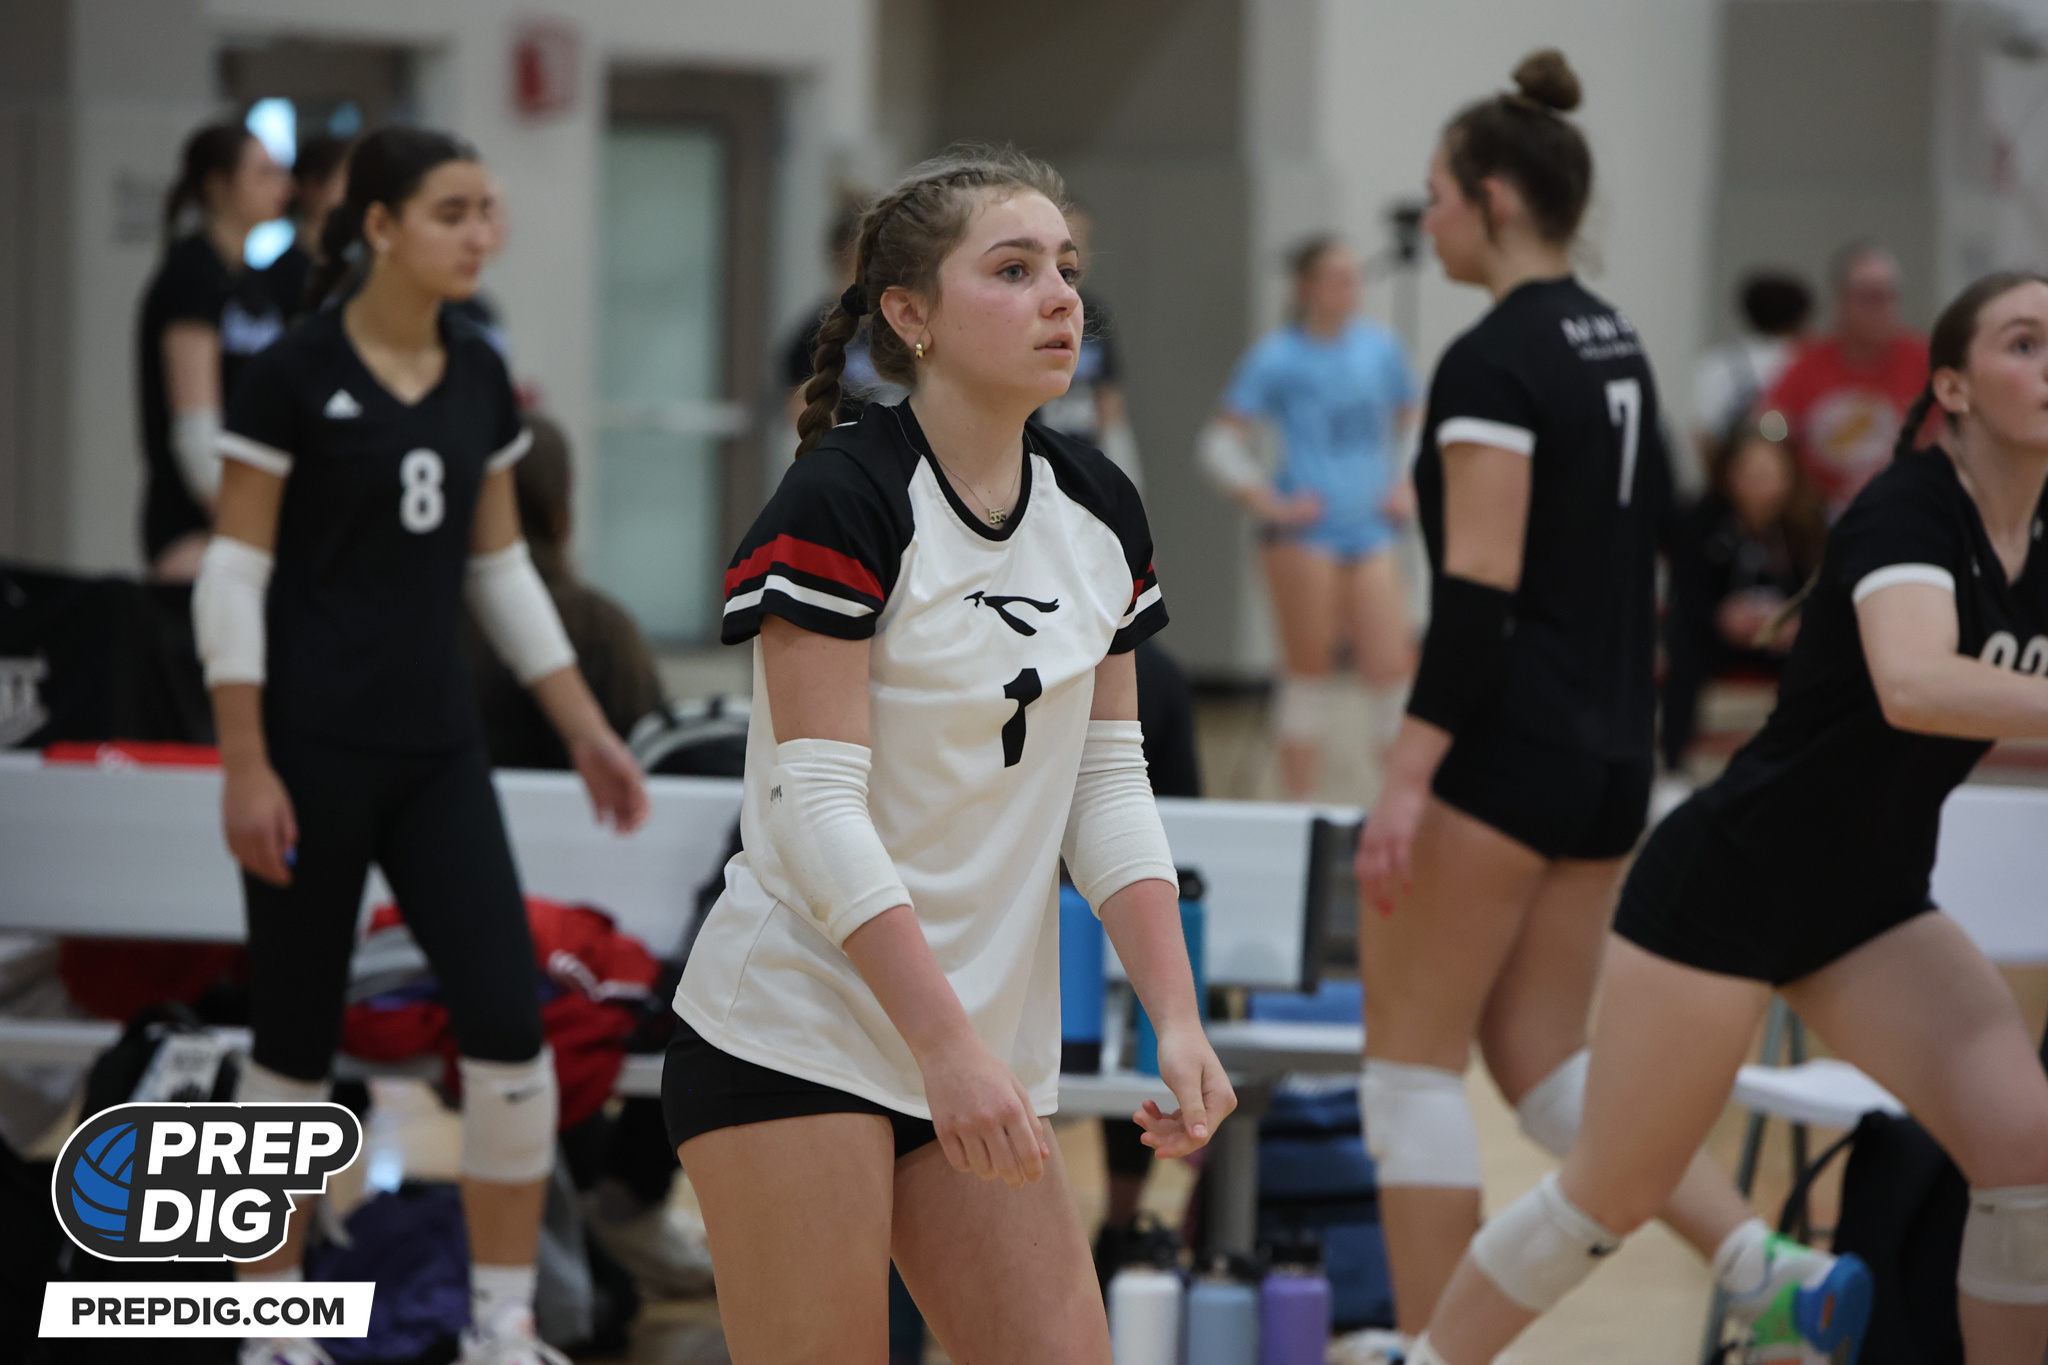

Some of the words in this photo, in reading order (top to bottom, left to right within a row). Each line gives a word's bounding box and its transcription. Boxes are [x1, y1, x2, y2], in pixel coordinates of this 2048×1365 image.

[400, 448, 445, 533] 8
[1604, 377, 1641, 506] 7
[1002, 668, 1042, 768] 1
